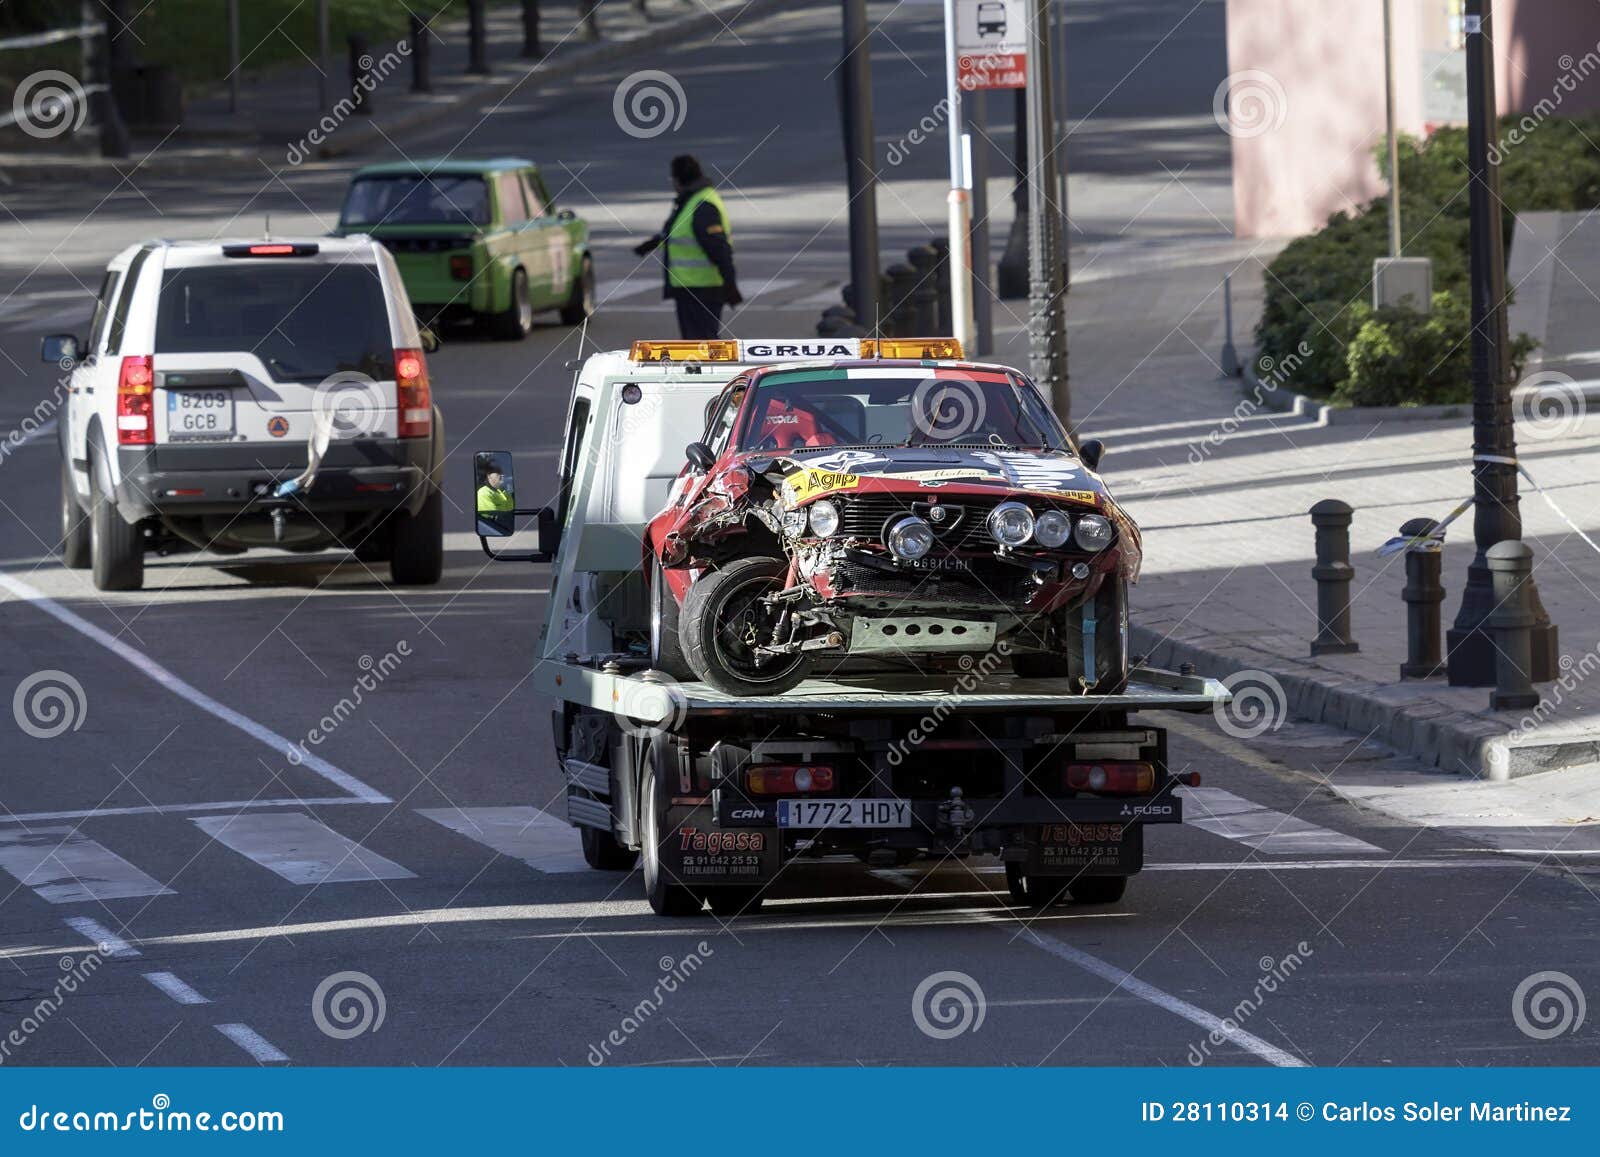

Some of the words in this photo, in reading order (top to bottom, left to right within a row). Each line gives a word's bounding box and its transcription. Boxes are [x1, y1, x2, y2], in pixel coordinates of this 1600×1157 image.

[746, 344, 853, 358] GRUA
[181, 392, 226, 409] 8209
[183, 413, 217, 430] GCB
[807, 471, 857, 490] Agip
[731, 808, 766, 819] CAN
[795, 802, 852, 825] 1772
[862, 802, 906, 825] HDY
[1133, 805, 1173, 815] FUSO
[679, 827, 764, 855] Tagasa
